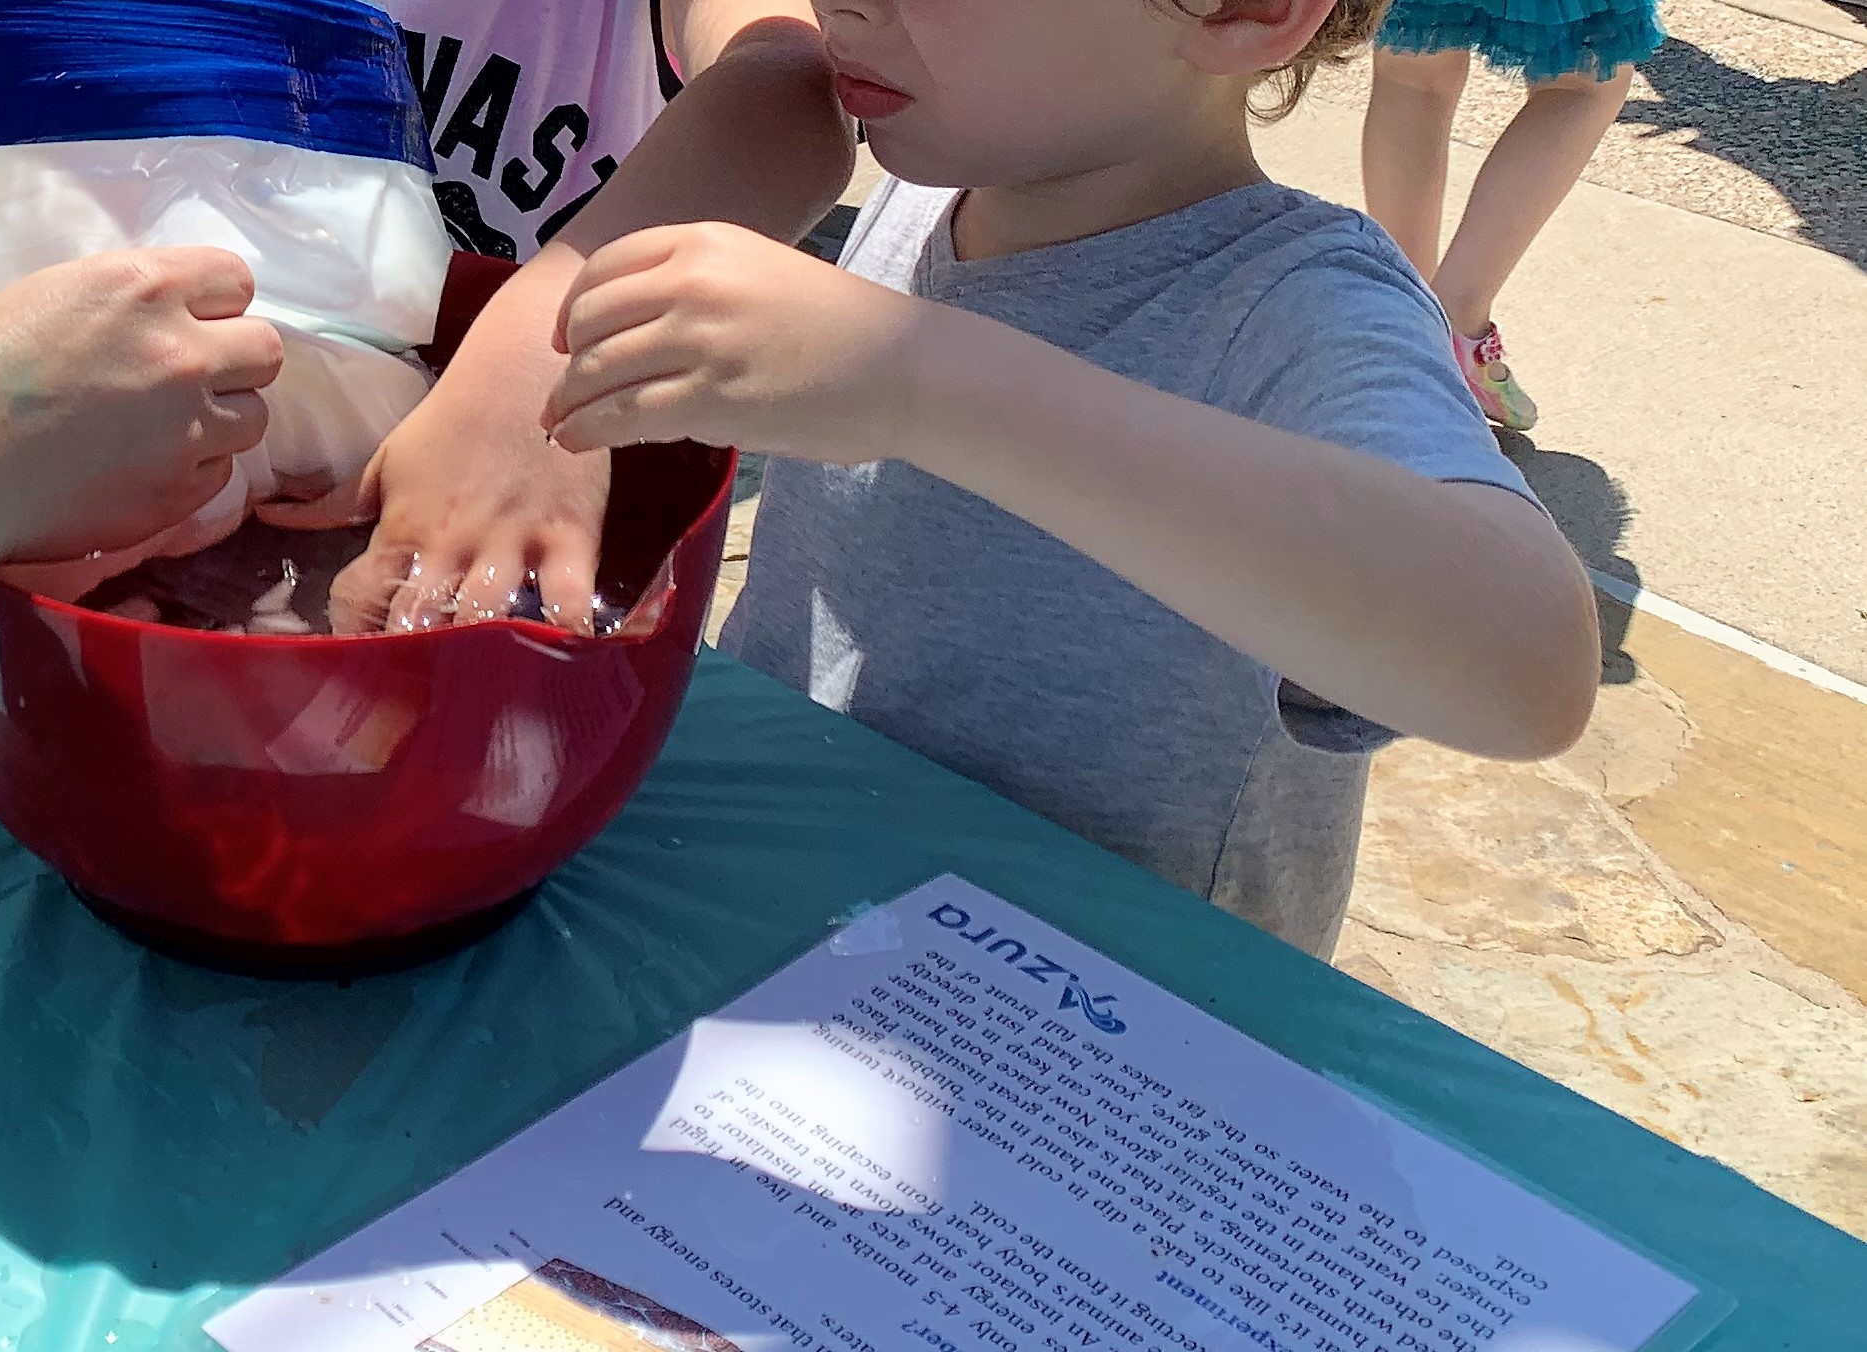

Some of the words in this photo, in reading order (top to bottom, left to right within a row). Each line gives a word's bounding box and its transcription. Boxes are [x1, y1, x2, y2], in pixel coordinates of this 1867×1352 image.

[925, 950, 956, 972] the
[927, 903, 1128, 1036] Azura
[887, 974, 941, 1008] water
[905, 961, 976, 1004] directly
[953, 970, 981, 985] of
[869, 985, 891, 1003] in
[983, 983, 1039, 1022] brunt
[831, 1013, 886, 1044] glove
[850, 997, 901, 1034] Place
[890, 997, 949, 1038] hands
[944, 1006, 977, 1030] the
[1039, 1017, 1077, 1043] full
[812, 1021, 881, 1071] turning
[949, 1032, 994, 1067] both
[980, 1026, 1002, 1045] in
[1004, 1042, 1054, 1077] keep
[1029, 1034, 1084, 1071] hand
[1080, 1041, 1114, 1065] the
[734, 1078, 765, 1100] the
[880, 1067, 955, 1117] without
[995, 1061, 1053, 1096] place
[1056, 1071, 1091, 1097] can
[1089, 1071, 1144, 1102] your
[1118, 1063, 1172, 1099] takes
[711, 1089, 734, 1103] of
[973, 1098, 1007, 1123] the
[985, 1080, 1043, 1116] great
[1047, 1095, 1097, 1128] Now
[1095, 1096, 1140, 1124] you
[1175, 1097, 1207, 1119] fat
[693, 1104, 714, 1120] to
[768, 1100, 806, 1126] into
[1040, 1111, 1056, 1125] a
[668, 1116, 723, 1156] frigid
[735, 1106, 810, 1157] transfer
[957, 1116, 1015, 1154] water
[1009, 1119, 1032, 1138] in
[1056, 1122, 1099, 1152] also
[1138, 1123, 1177, 1149] one
[1212, 1118, 1247, 1144] the
[717, 1122, 802, 1181] insulator
[720, 1155, 750, 1173] in
[809, 1123, 892, 1180] escaping
[1015, 1150, 1063, 1182] cold
[1029, 1133, 1085, 1173] hand
[1099, 1149, 1120, 1167] is
[1253, 1143, 1280, 1161] so
[812, 1156, 846, 1180] the
[1086, 1168, 1127, 1195] one
[1119, 1161, 1164, 1194] that
[1182, 1146, 1244, 1191] which
[1213, 1144, 1300, 1200] blubber
[755, 1172, 793, 1203] live
[807, 1179, 834, 1200] an
[848, 1177, 905, 1217] down
[895, 1180, 944, 1217] from
[1066, 1180, 1090, 1202] in
[1159, 1160, 1238, 1211] regular
[1164, 1188, 1196, 1213] fat
[602, 1196, 645, 1225] and
[793, 1200, 837, 1230] and
[837, 1201, 864, 1219] as
[1092, 1198, 1128, 1223] dip
[1129, 1194, 1186, 1235] Place
[1198, 1208, 1214, 1222] a
[1250, 1190, 1291, 1215] see
[1309, 1199, 1347, 1226] the
[1358, 1202, 1395, 1229] the
[867, 1220, 911, 1250] acts
[906, 1214, 968, 1258] slows
[945, 1212, 993, 1251] heat
[1131, 1221, 1147, 1235] a
[1240, 1209, 1278, 1236] the
[1290, 1214, 1337, 1244] and
[1403, 1228, 1427, 1247] to
[641, 1224, 709, 1271] energy
[1018, 1233, 1054, 1260] the
[1149, 1234, 1197, 1268] take
[1280, 1231, 1306, 1254] in
[1356, 1224, 1421, 1271] Using
[841, 1232, 920, 1287] months
[910, 1250, 957, 1282] and
[993, 1247, 1049, 1288] body
[1304, 1248, 1367, 1291] hand
[1339, 1244, 1407, 1287] water
[1056, 1255, 1110, 1296] from
[1200, 1265, 1225, 1286] to
[1431, 1246, 1531, 1306] exposed
[708, 1269, 773, 1315] stores
[921, 1289, 961, 1316] 4-5
[966, 1258, 1065, 1326] insulator
[1107, 1291, 1130, 1310] it
[1228, 1283, 1272, 1316] like
[1414, 1287, 1451, 1314] ice
[959, 1284, 1035, 1334] energy
[1288, 1290, 1370, 1349] human
[1342, 1295, 1393, 1335] with
[1367, 1287, 1433, 1329] other
[768, 1312, 813, 1348] that
[819, 1312, 875, 1351] aters.
[967, 1319, 1017, 1351] only
[1067, 1319, 1102, 1347] An
[1455, 1313, 1496, 1341] the
